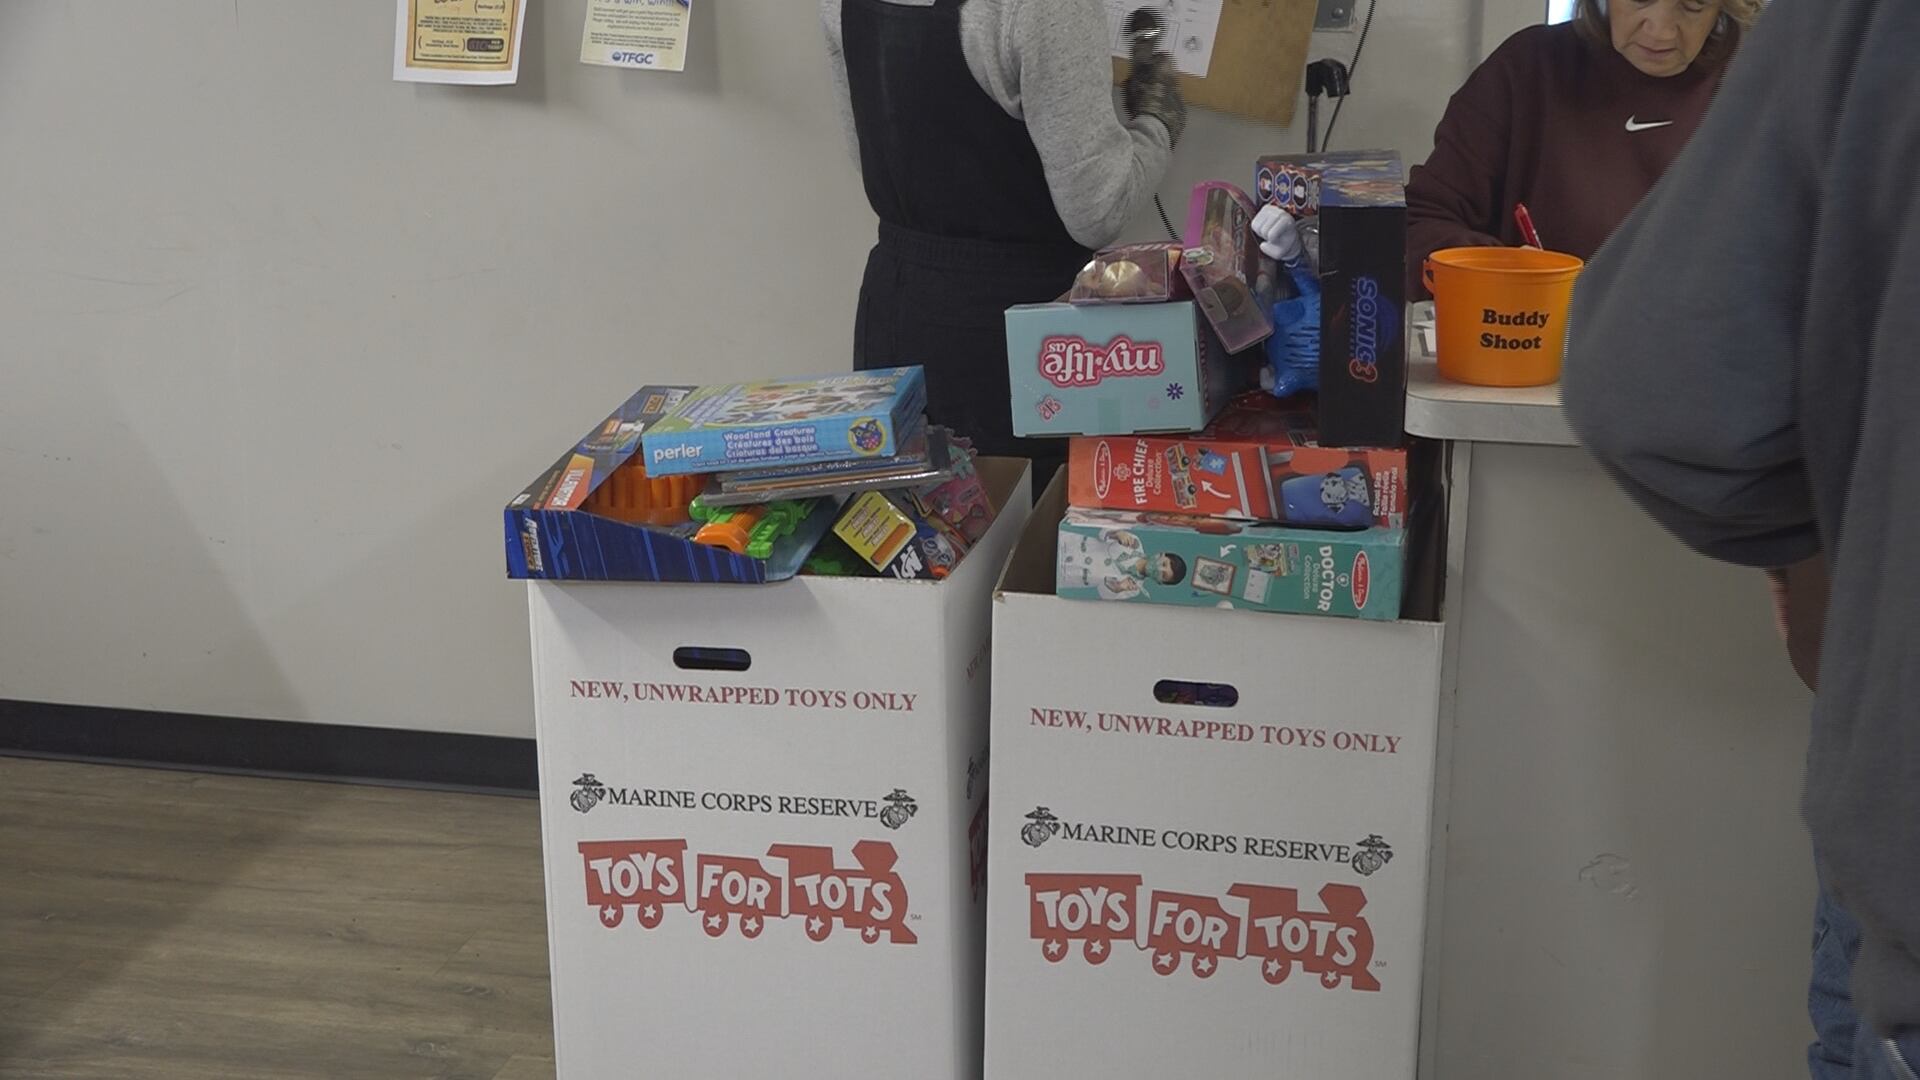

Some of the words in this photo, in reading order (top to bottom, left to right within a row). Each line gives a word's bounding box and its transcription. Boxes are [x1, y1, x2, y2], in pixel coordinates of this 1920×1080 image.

[622, 52, 654, 64] TFGC
[1356, 276, 1378, 365] SONIC
[1482, 309, 1549, 328] Buddy
[1480, 333, 1542, 350] Shoot
[724, 430, 771, 441] Woodland
[774, 427, 815, 437] Creatures
[653, 443, 703, 463] perler
[1132, 438, 1149, 476] CHIEF
[1132, 477, 1148, 505] FIRE
[1153, 452, 1162, 496] Collection
[1317, 545, 1335, 611] DOCTOR
[570, 680, 630, 702] NEW,
[634, 683, 780, 707] UNWRAPPED
[785, 689, 847, 709] TOYS
[853, 691, 917, 711] ONLY
[1030, 707, 1092, 734] NEW,
[1098, 712, 1254, 743] UNWRAPPED
[1261, 725, 1326, 748] TOYS
[1333, 731, 1402, 754] ONLY
[608, 787, 697, 809] MARINE
[701, 791, 773, 813] CORPS
[779, 796, 879, 818] RESERVE
[1062, 821, 1156, 847] MARINE
[1162, 830, 1237, 854] CORPS
[1243, 837, 1351, 863] RESERVE
[589, 851, 680, 898] TOYS
[700, 864, 772, 910] FOR
[794, 873, 893, 921] TOTS
[1035, 886, 1130, 932] TOYS
[1153, 901, 1229, 950] FOR
[1254, 916, 1358, 966] TOTS
